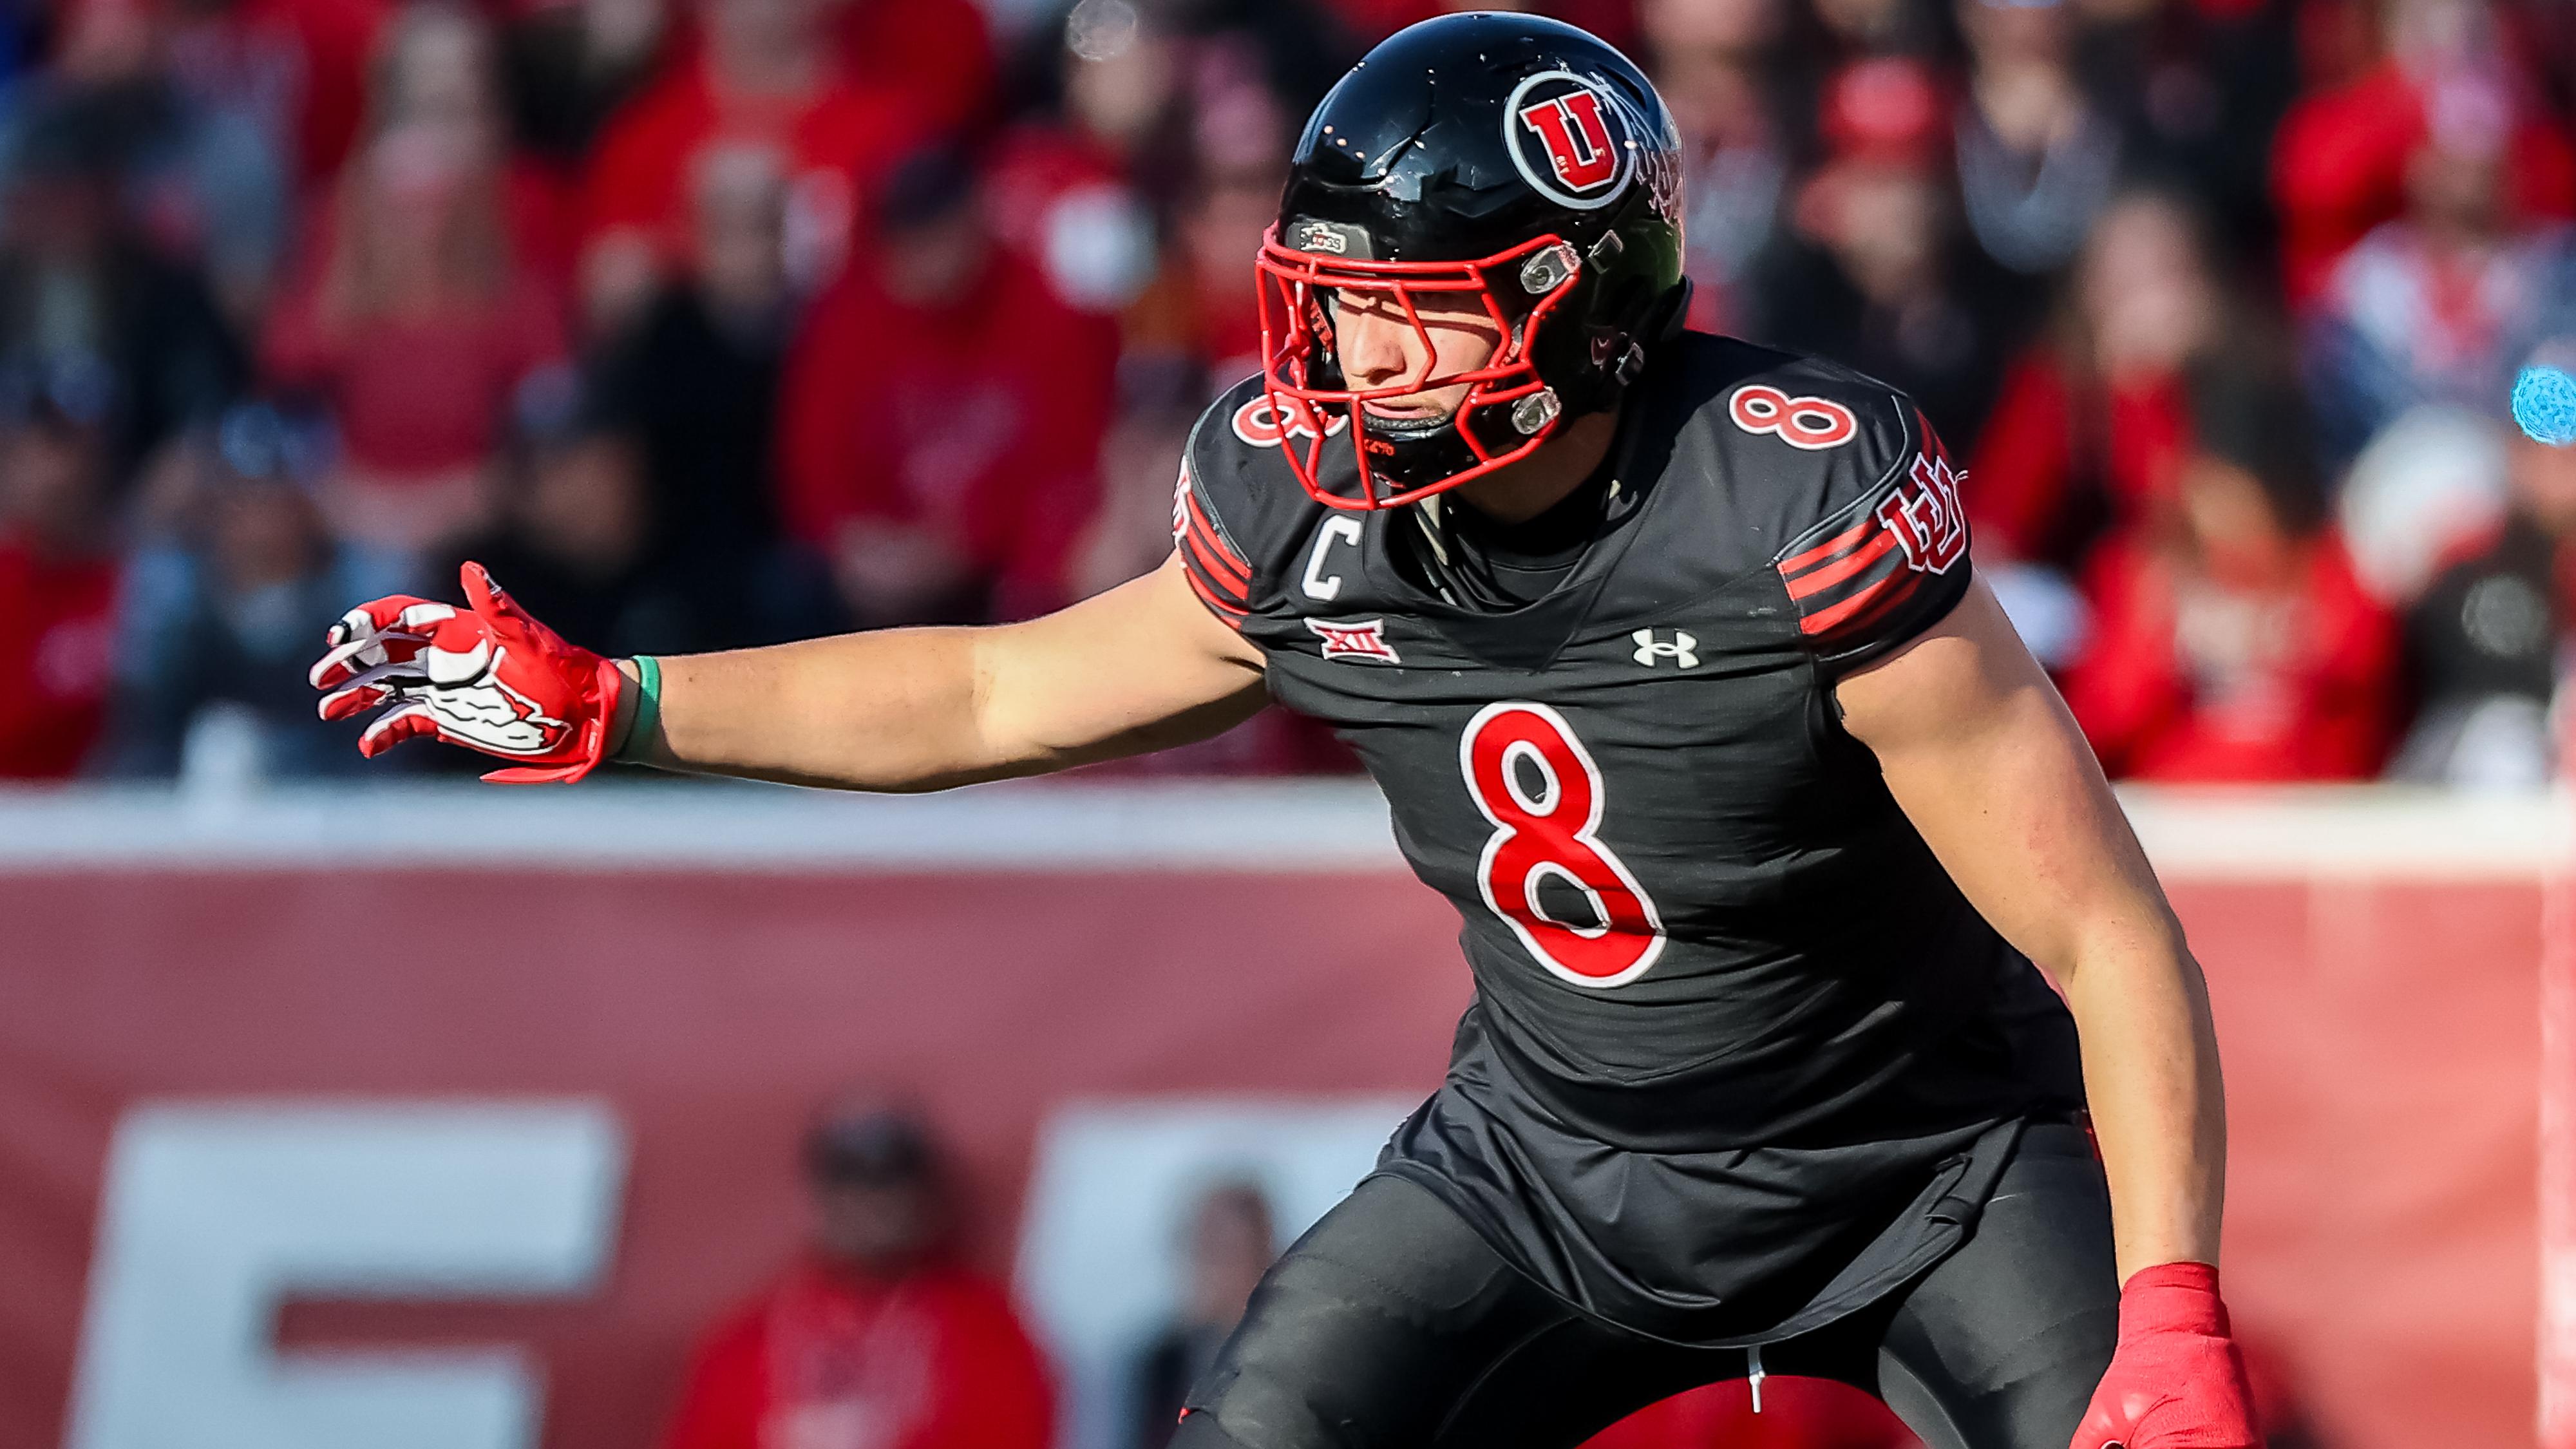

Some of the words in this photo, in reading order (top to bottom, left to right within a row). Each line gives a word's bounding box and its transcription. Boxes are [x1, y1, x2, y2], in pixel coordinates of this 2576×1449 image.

[1519, 89, 1620, 192] U
[1728, 384, 1859, 450] 8
[1301, 515, 1362, 601] C
[1303, 617, 1401, 664] XII
[1459, 701, 1667, 988] 8
